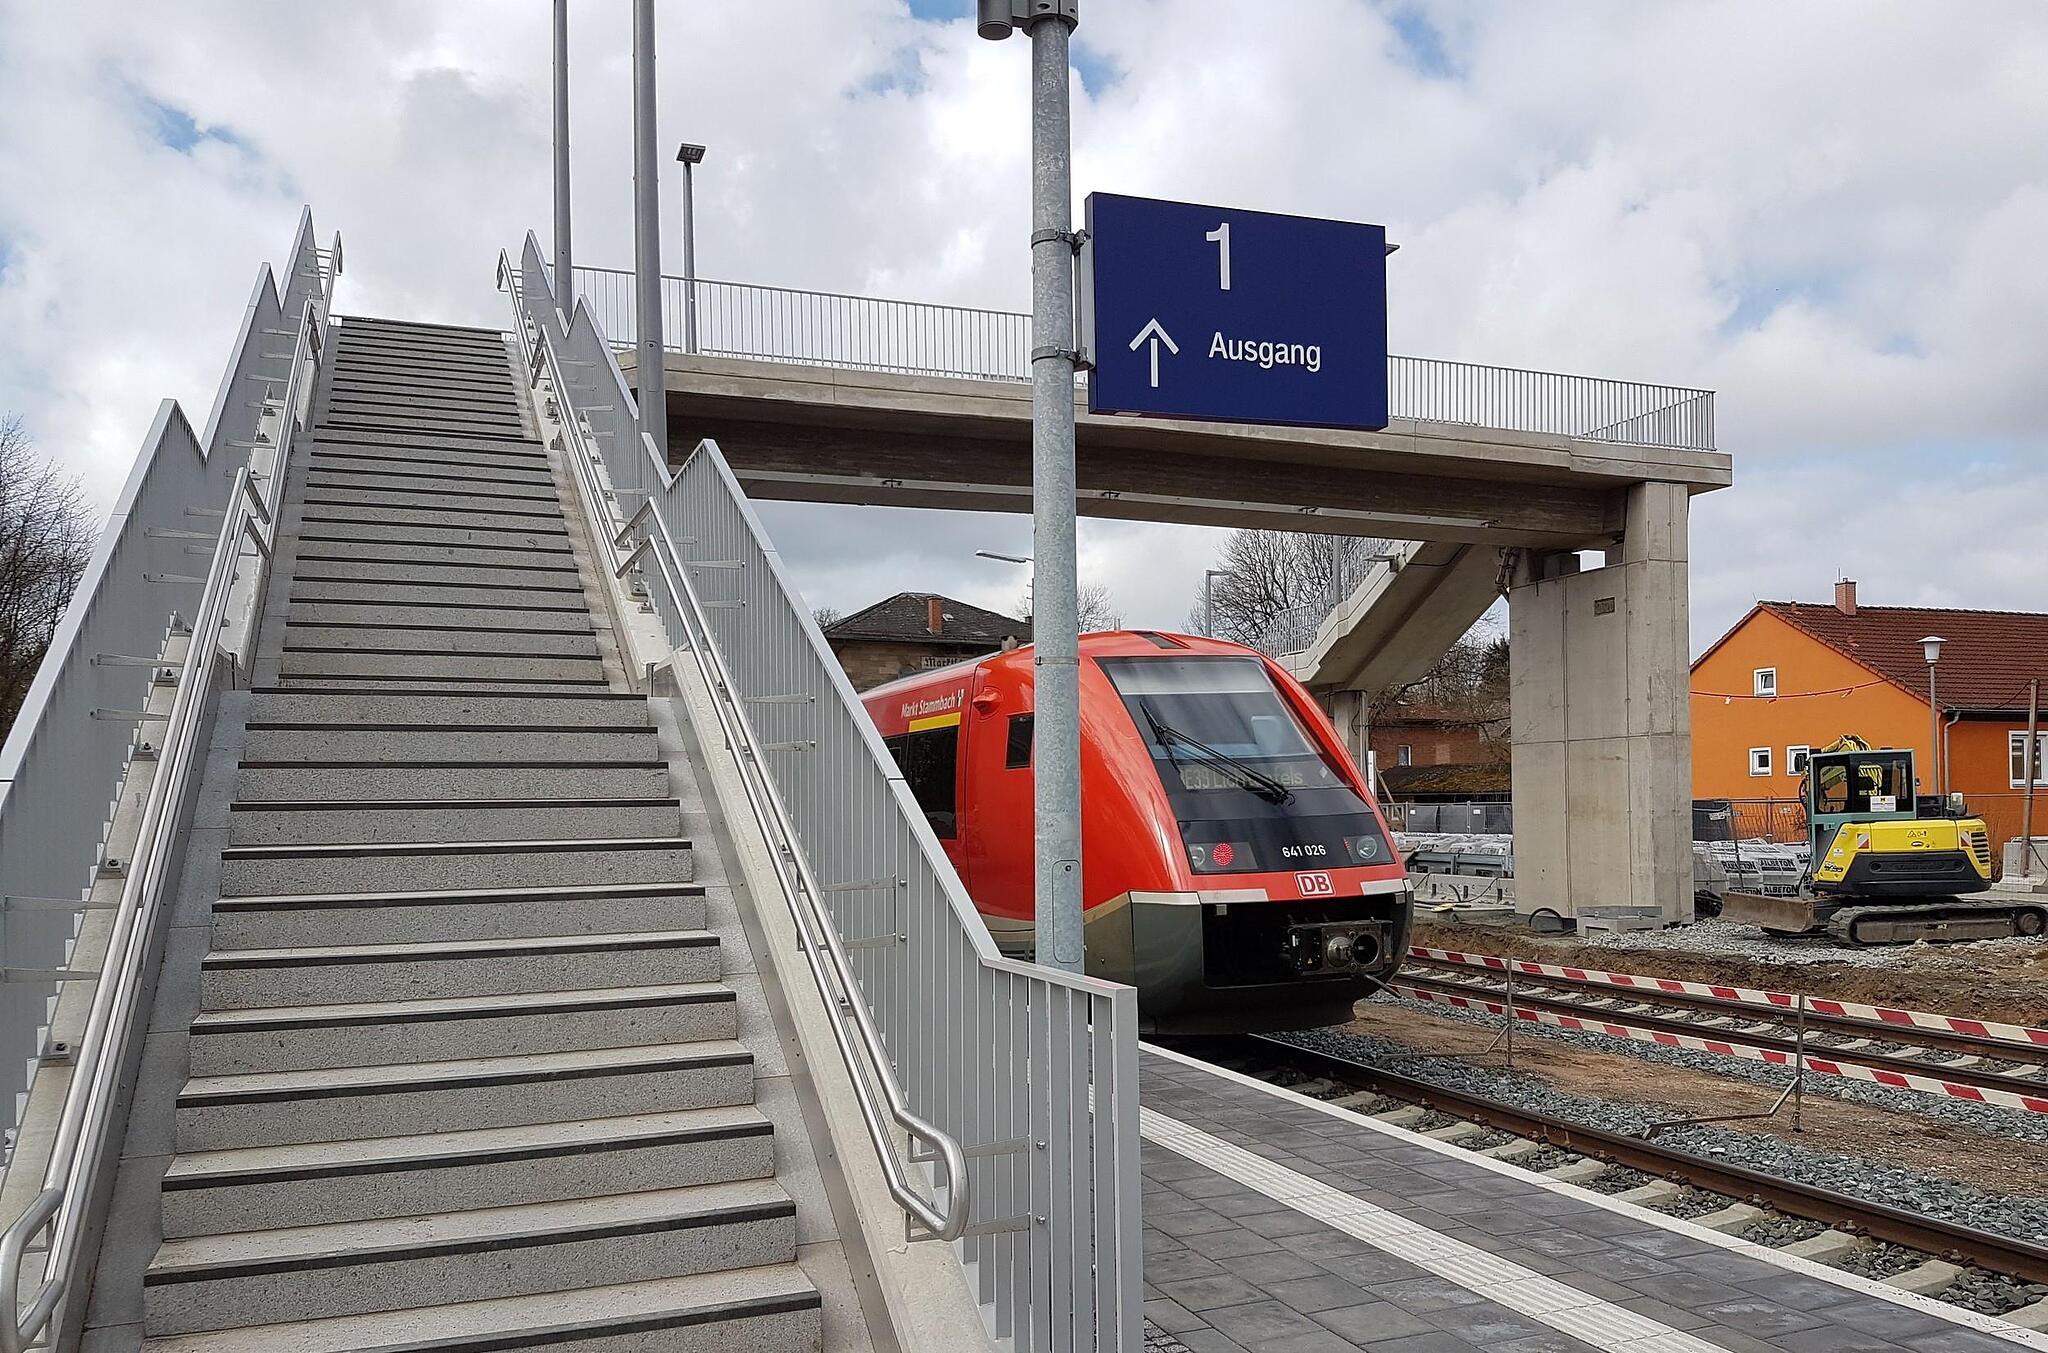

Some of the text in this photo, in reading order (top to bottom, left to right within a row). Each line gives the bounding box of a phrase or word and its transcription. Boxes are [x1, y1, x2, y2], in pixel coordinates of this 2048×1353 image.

[1205, 222, 1231, 291] 1
[1208, 331, 1322, 372] Ausgang
[901, 692, 956, 719] Markt Stammbach
[1282, 844, 1326, 858] 641 026
[1298, 874, 1331, 894] DB
